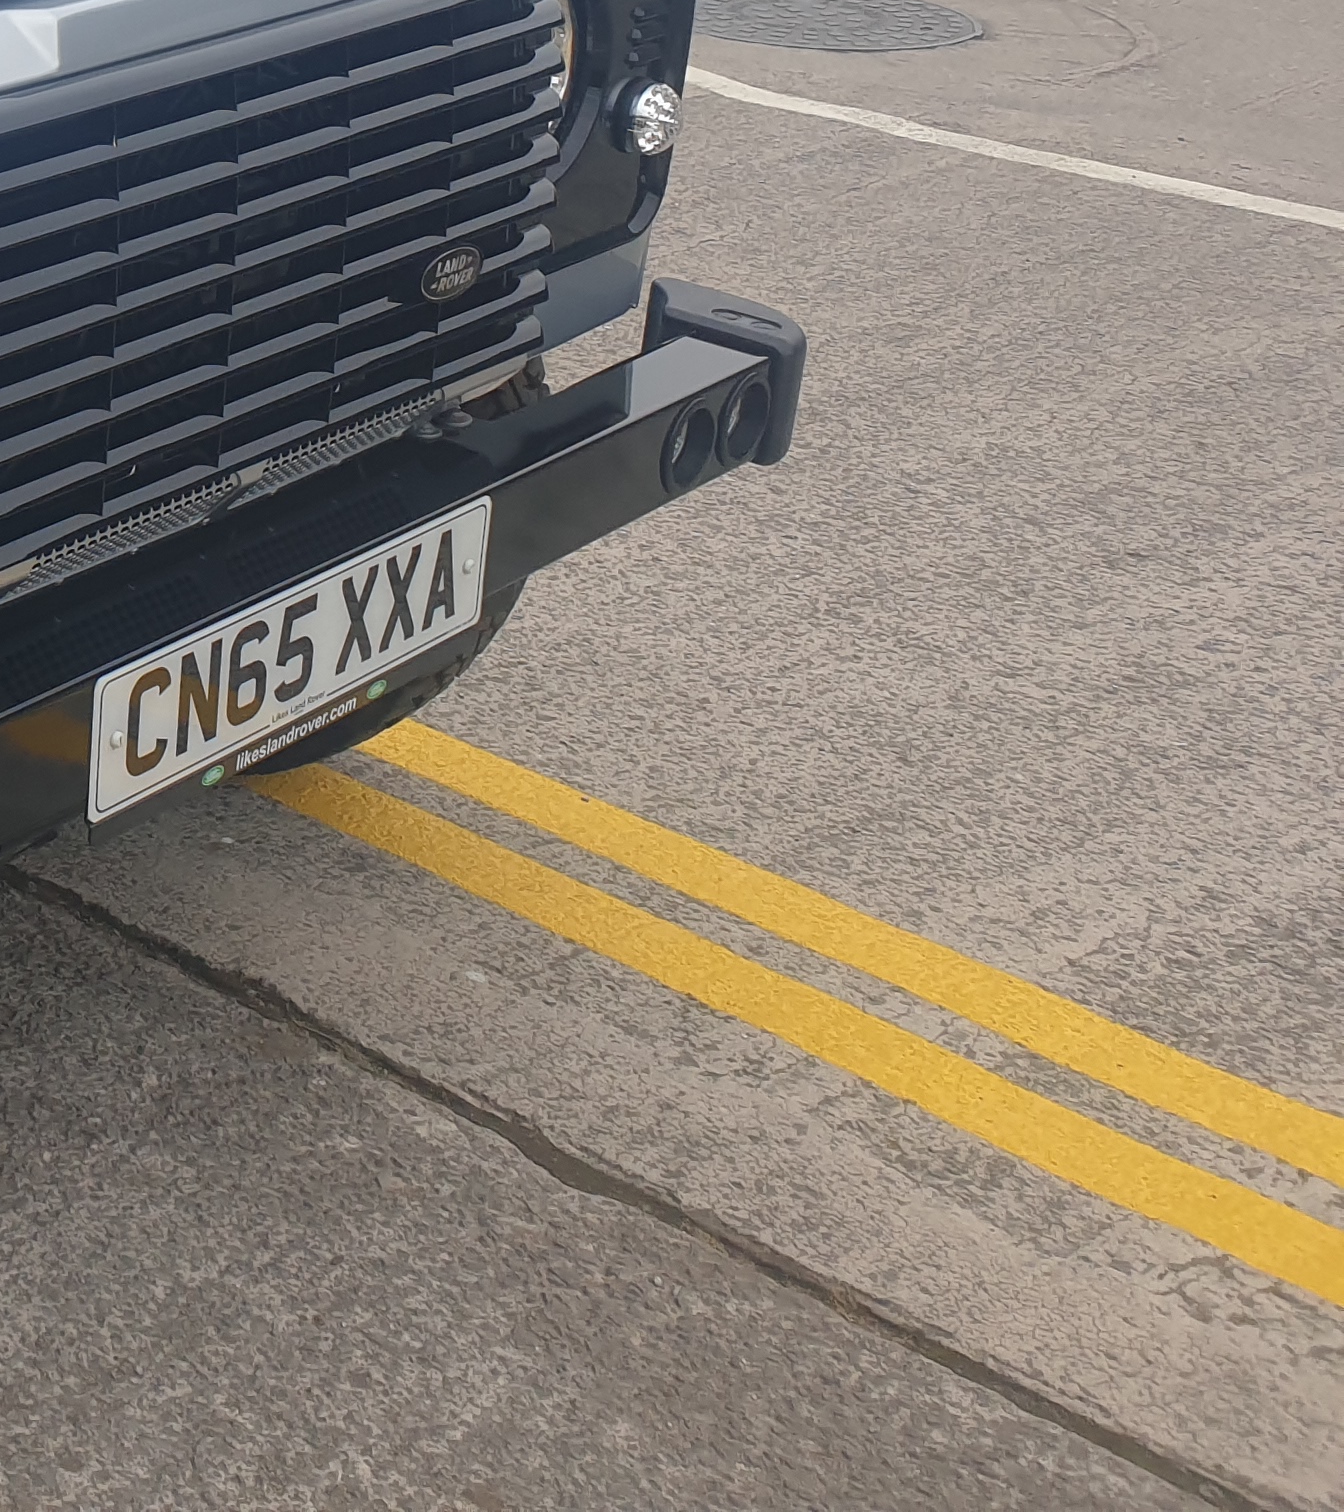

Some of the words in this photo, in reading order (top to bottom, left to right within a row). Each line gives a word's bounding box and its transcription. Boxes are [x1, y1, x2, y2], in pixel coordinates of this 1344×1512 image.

[435, 254, 467, 278] LAND
[436, 266, 474, 294] ROVER
[125, 591, 318, 777] CN65
[334, 528, 456, 677] XXA
[235, 696, 358, 772] likeslandrover.com
